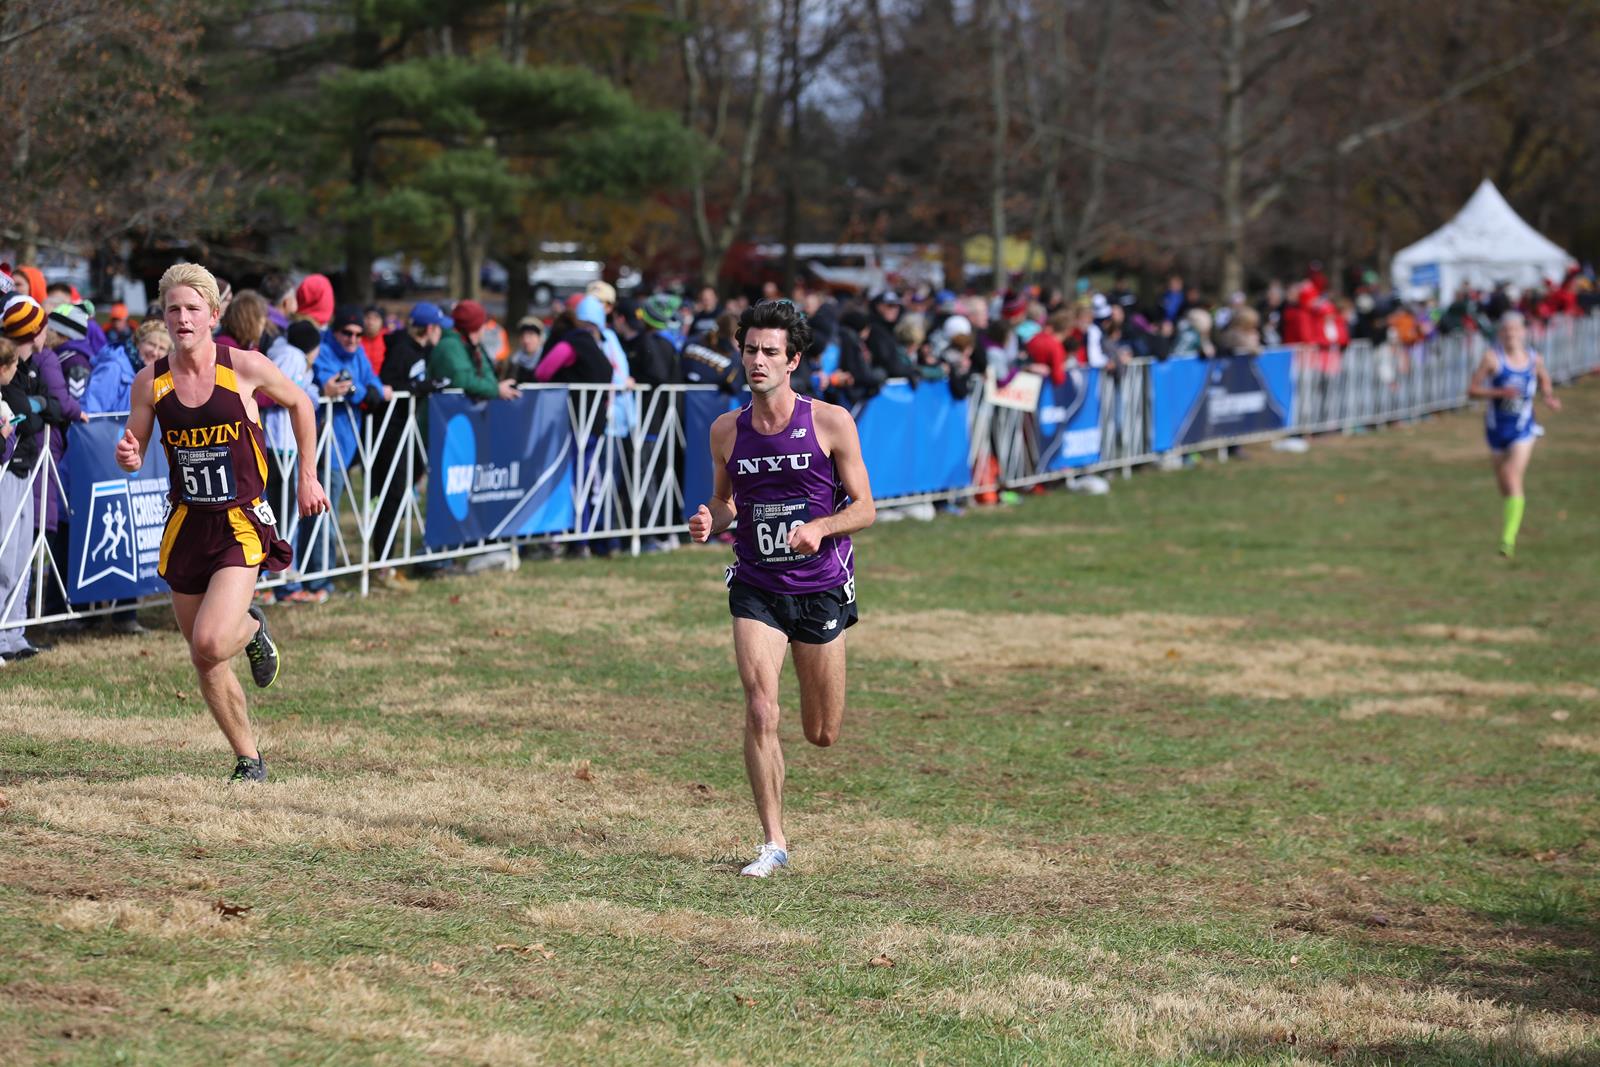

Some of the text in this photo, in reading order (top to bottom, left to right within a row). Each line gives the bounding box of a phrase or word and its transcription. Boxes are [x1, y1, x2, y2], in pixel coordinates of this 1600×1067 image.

[166, 421, 242, 448] CALVIN
[737, 453, 812, 475] NYU
[182, 465, 229, 496] 511
[782, 504, 806, 512] COUNTRY
[757, 520, 806, 555] 64
